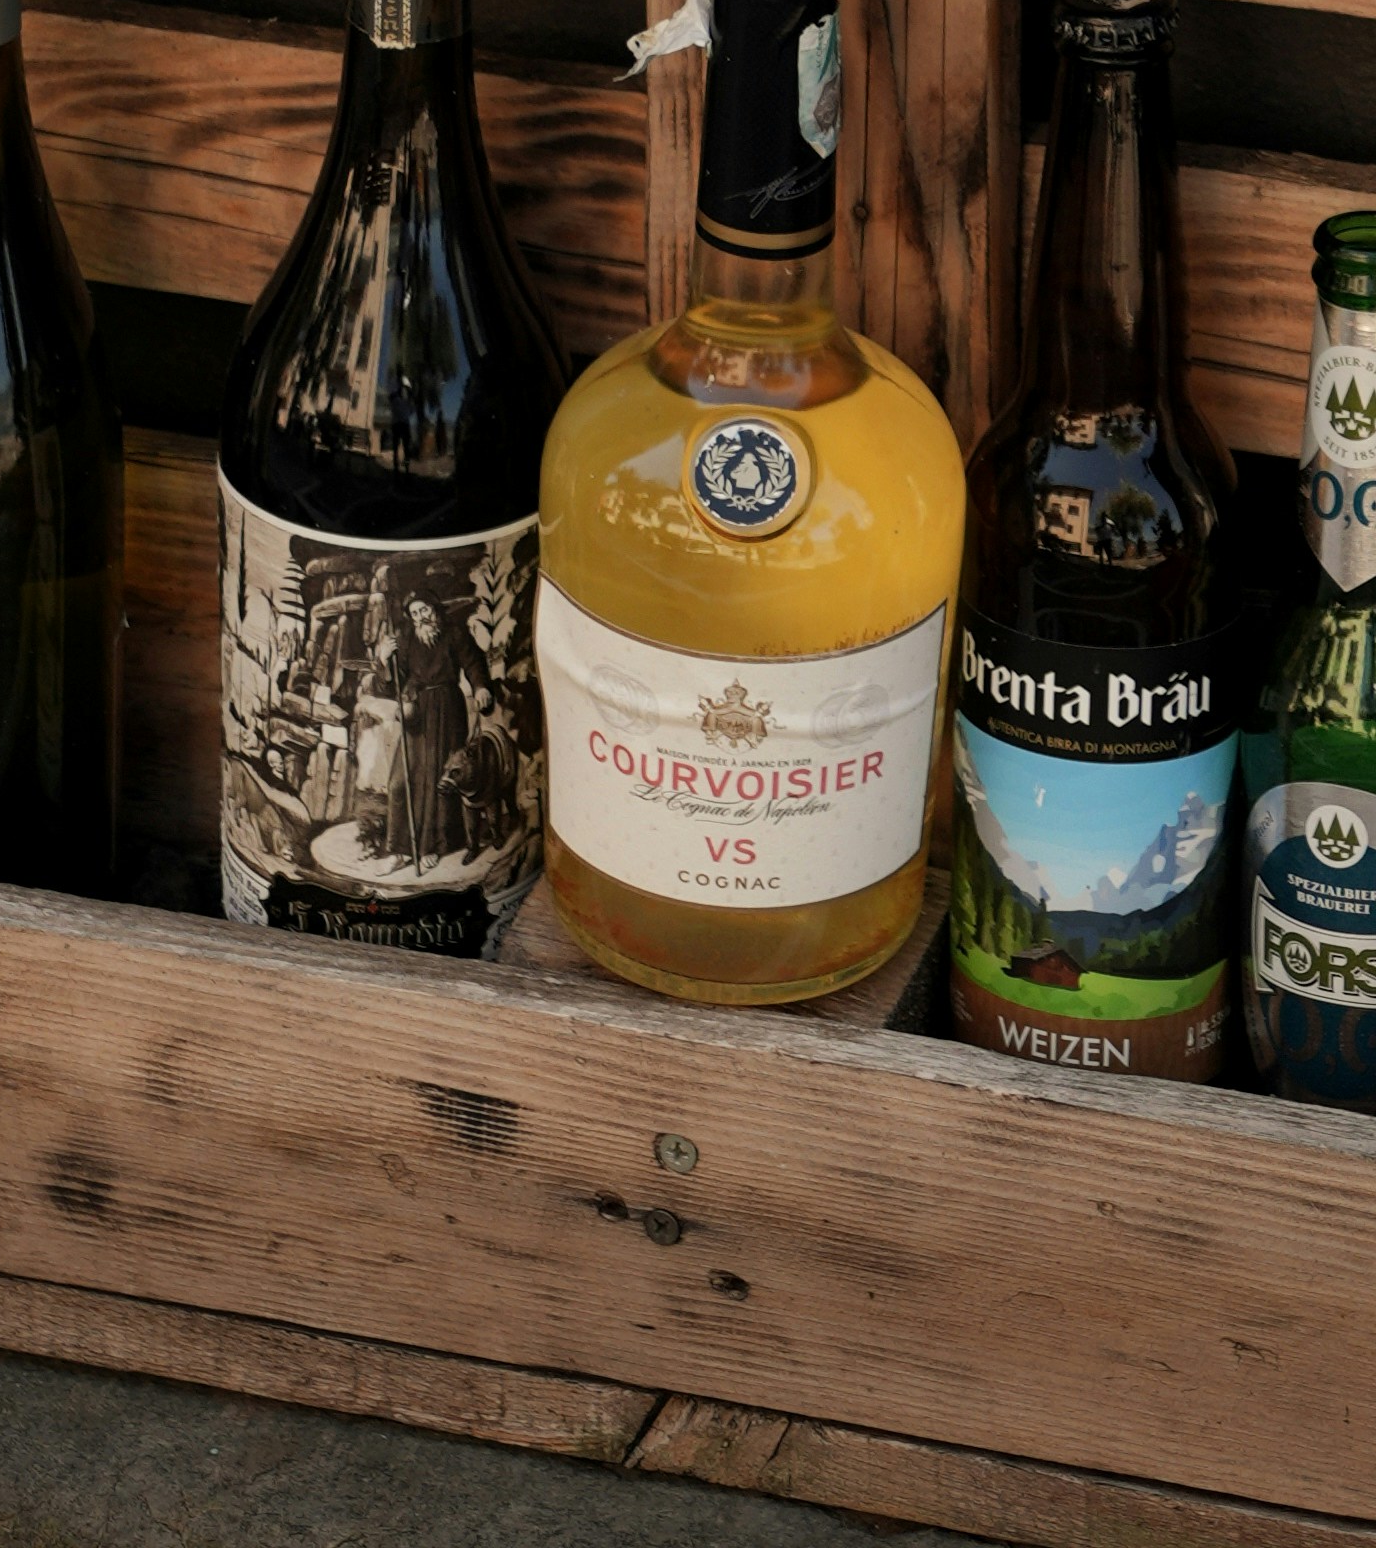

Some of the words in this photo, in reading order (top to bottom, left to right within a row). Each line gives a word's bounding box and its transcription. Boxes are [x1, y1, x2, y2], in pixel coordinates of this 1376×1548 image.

[960, 624, 1093, 730] Brenta
[1106, 670, 1212, 732] Bräu
[1045, 735, 1083, 753] BIRRA
[1084, 741, 1100, 755] DI
[1101, 740, 1179, 758] MONTAGNA
[587, 729, 886, 802] COURVOISIER
[704, 835, 758, 866] VS
[676, 869, 782, 892] COGNAC
[1295, 889, 1372, 916] BRAUEREI
[996, 1014, 1132, 1069] WEIZEN
